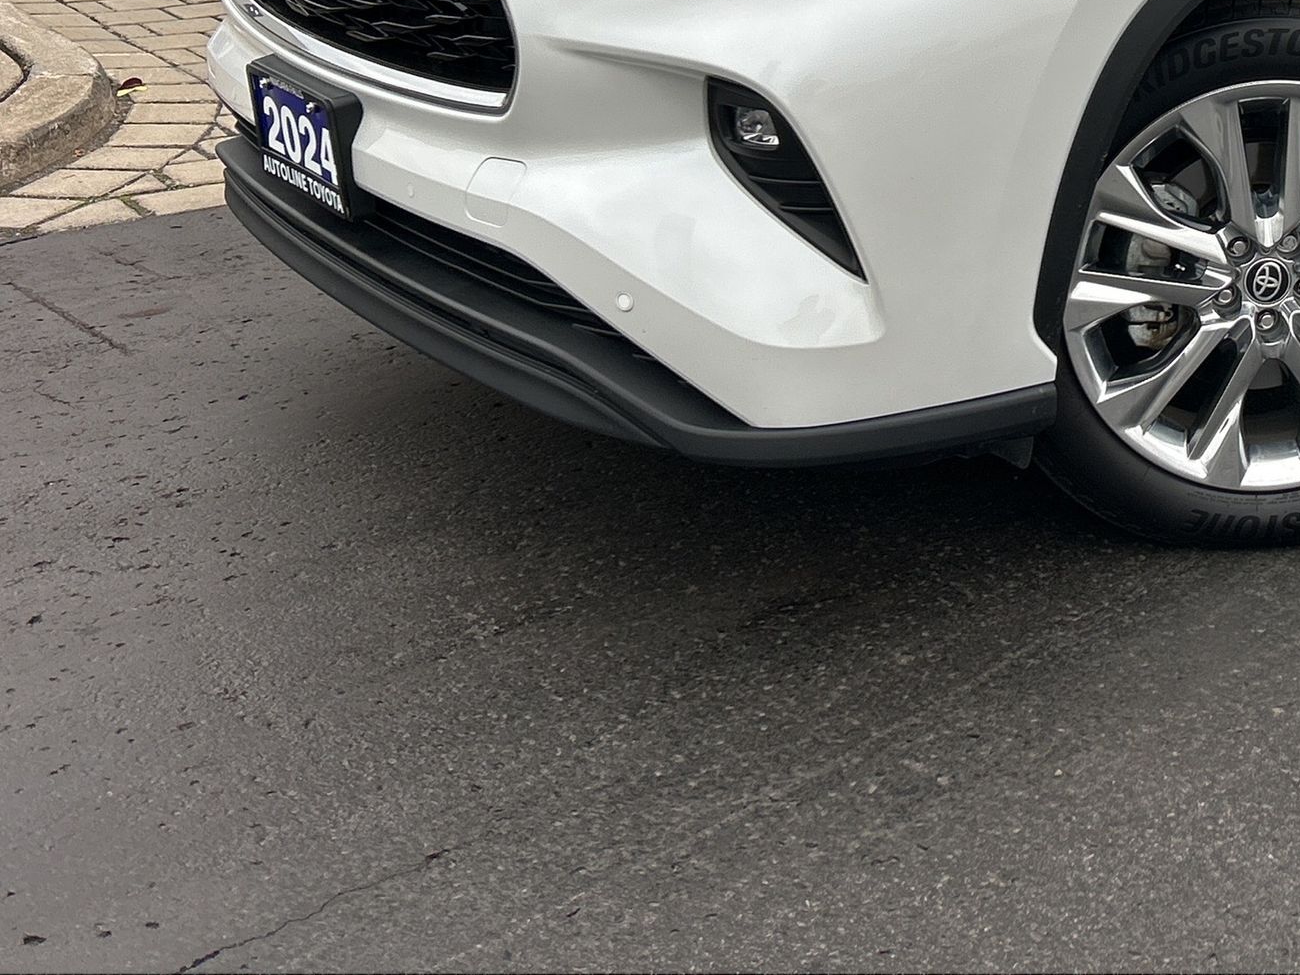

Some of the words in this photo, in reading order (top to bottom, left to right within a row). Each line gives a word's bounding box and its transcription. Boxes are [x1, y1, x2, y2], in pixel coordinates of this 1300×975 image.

[263, 96, 339, 186] 2024
[263, 154, 309, 193] AUTOLINE
[306, 176, 345, 214] TOYOTA
